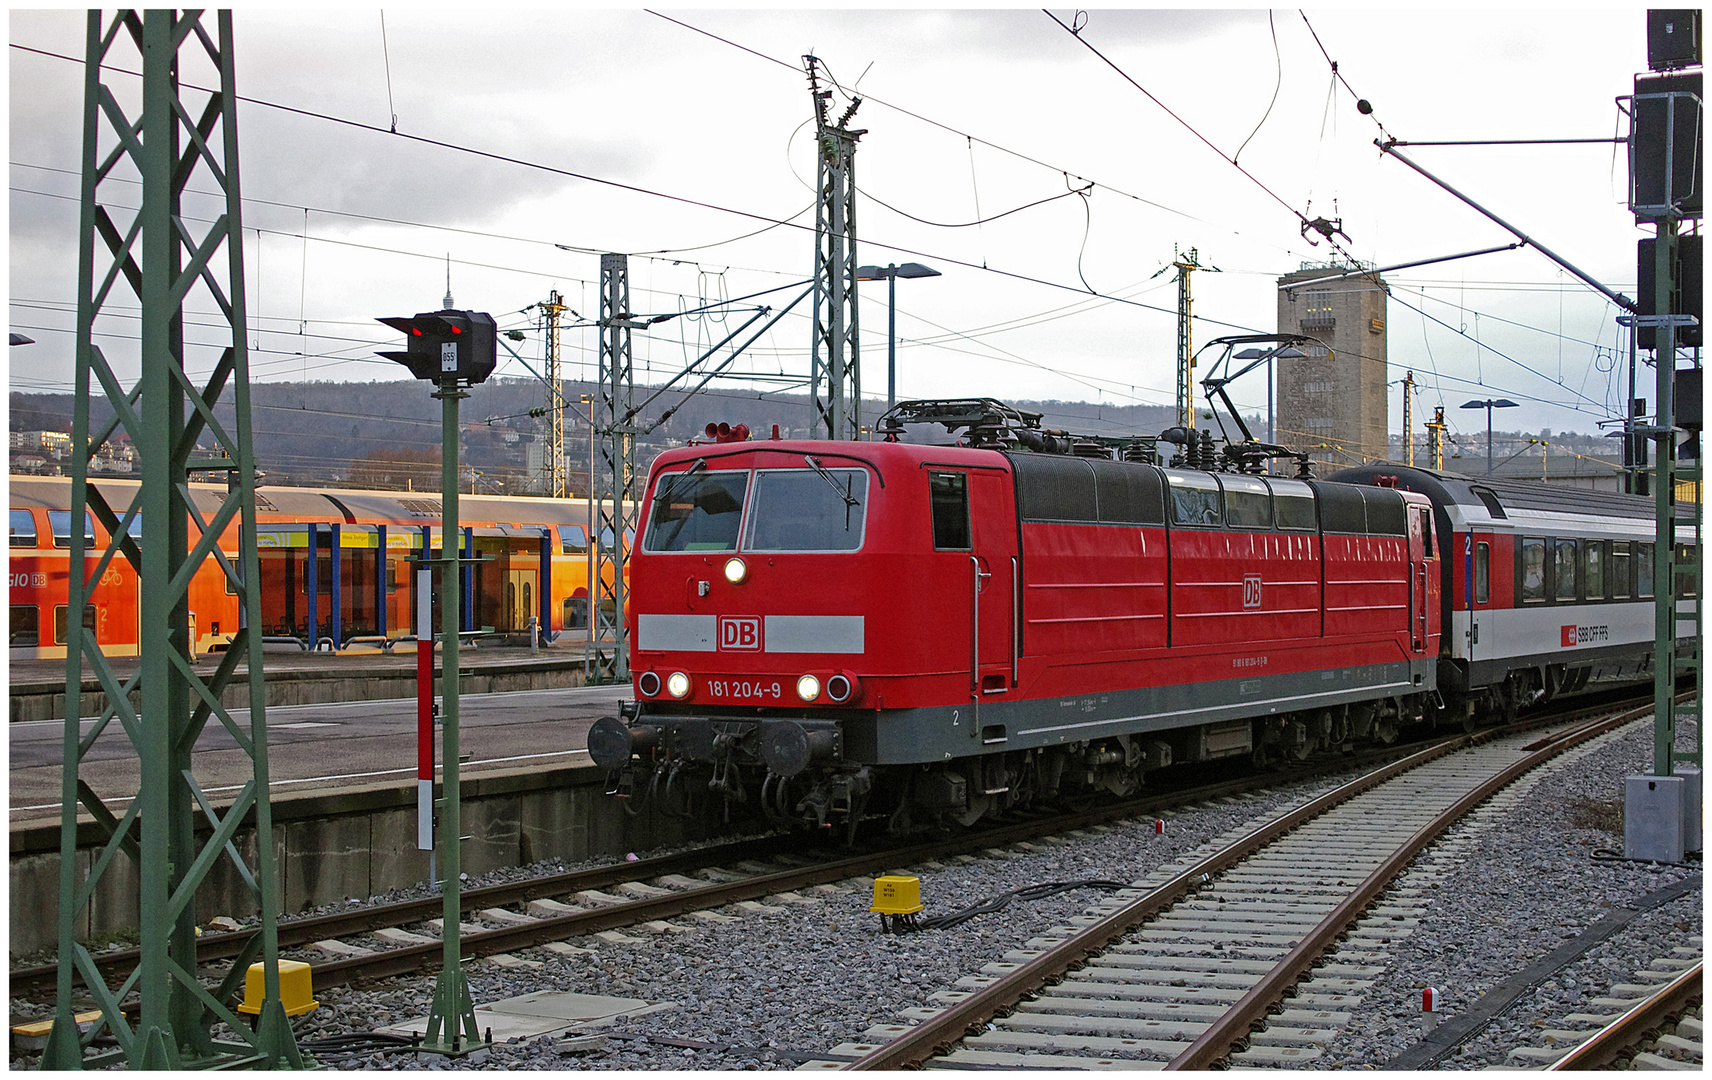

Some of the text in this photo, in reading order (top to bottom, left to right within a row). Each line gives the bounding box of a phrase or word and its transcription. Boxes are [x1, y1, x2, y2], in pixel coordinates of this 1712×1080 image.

[1465, 536, 1471, 555] 2
[32, 574, 46, 586] DB
[1244, 579, 1260, 605] DB
[101, 608, 107, 621] 2
[722, 620, 757, 647] DB
[1578, 625, 1608, 642] SBB CFF FFS
[707, 681, 781, 698] 181 204-9
[953, 709, 959, 726] 2
